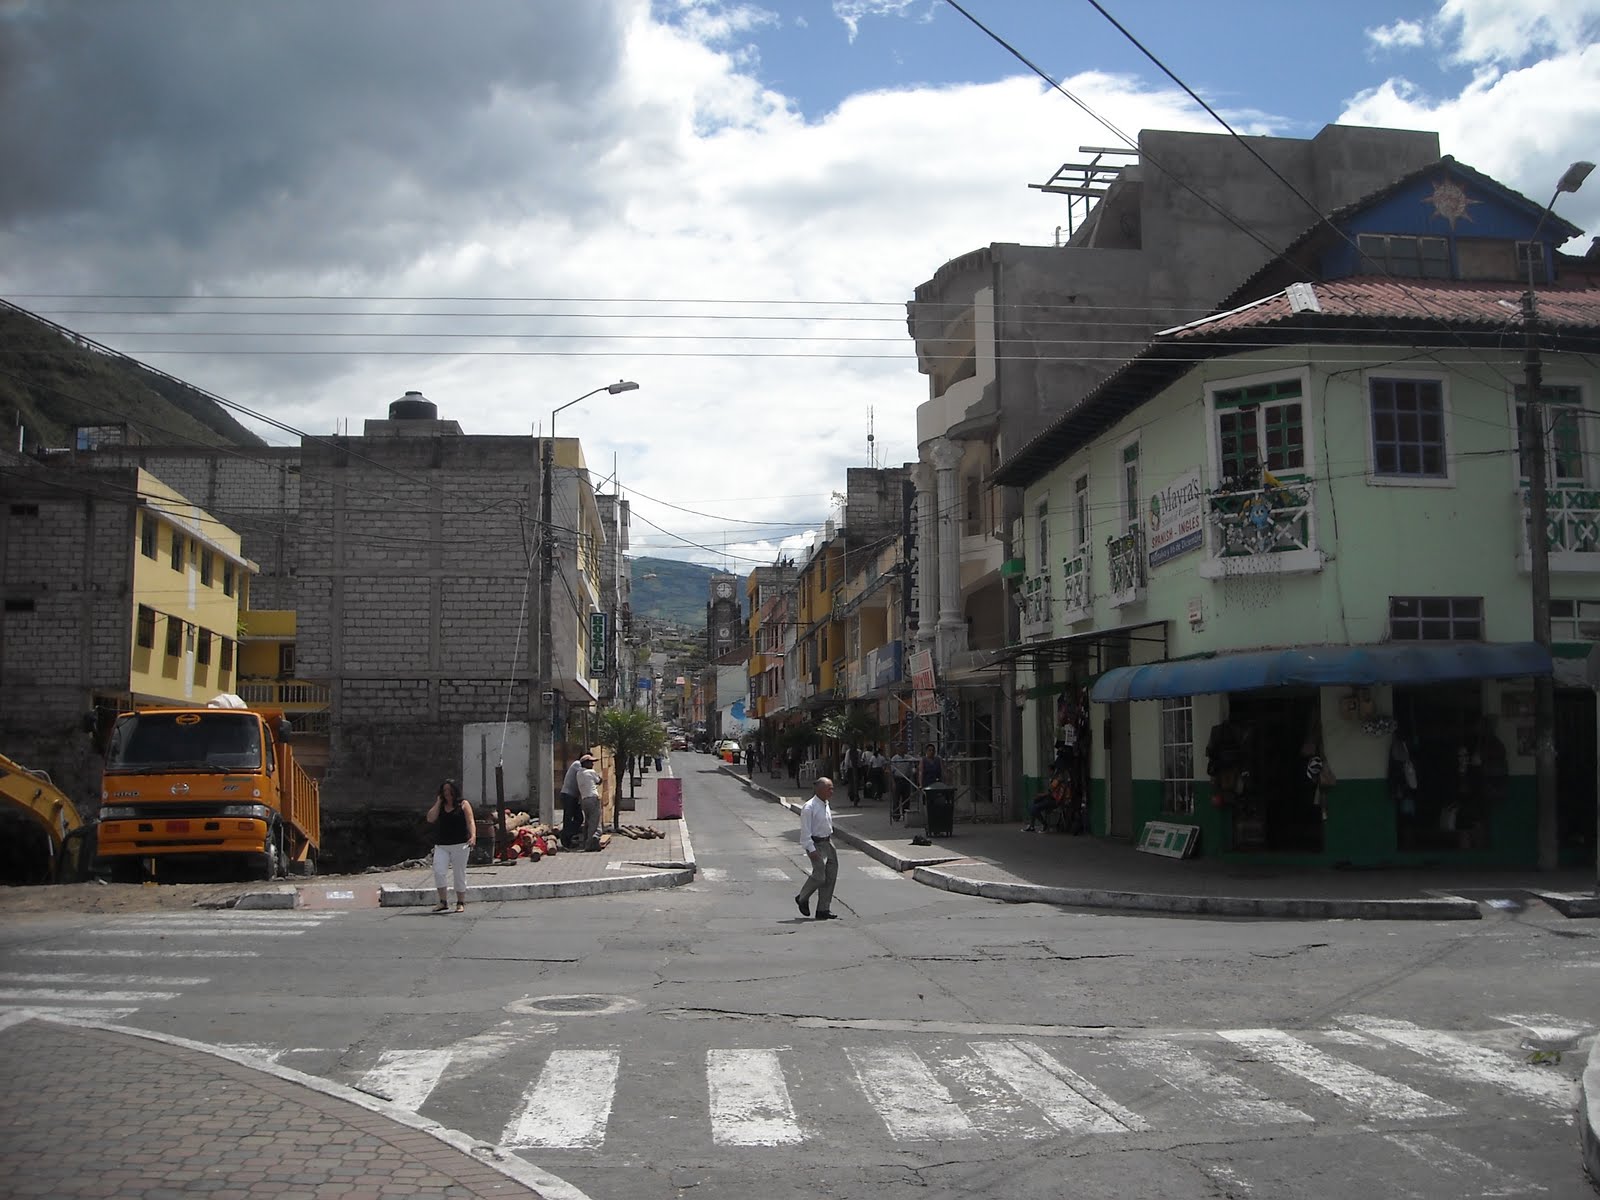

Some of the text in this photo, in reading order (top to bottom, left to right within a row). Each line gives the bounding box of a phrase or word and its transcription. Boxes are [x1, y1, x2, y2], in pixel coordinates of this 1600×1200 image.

[1161, 478, 1199, 515] Mayra's
[1152, 527, 1173, 548] SPANISH
[1179, 515, 1199, 535] INGLES
[592, 615, 604, 670] HOSTAL
